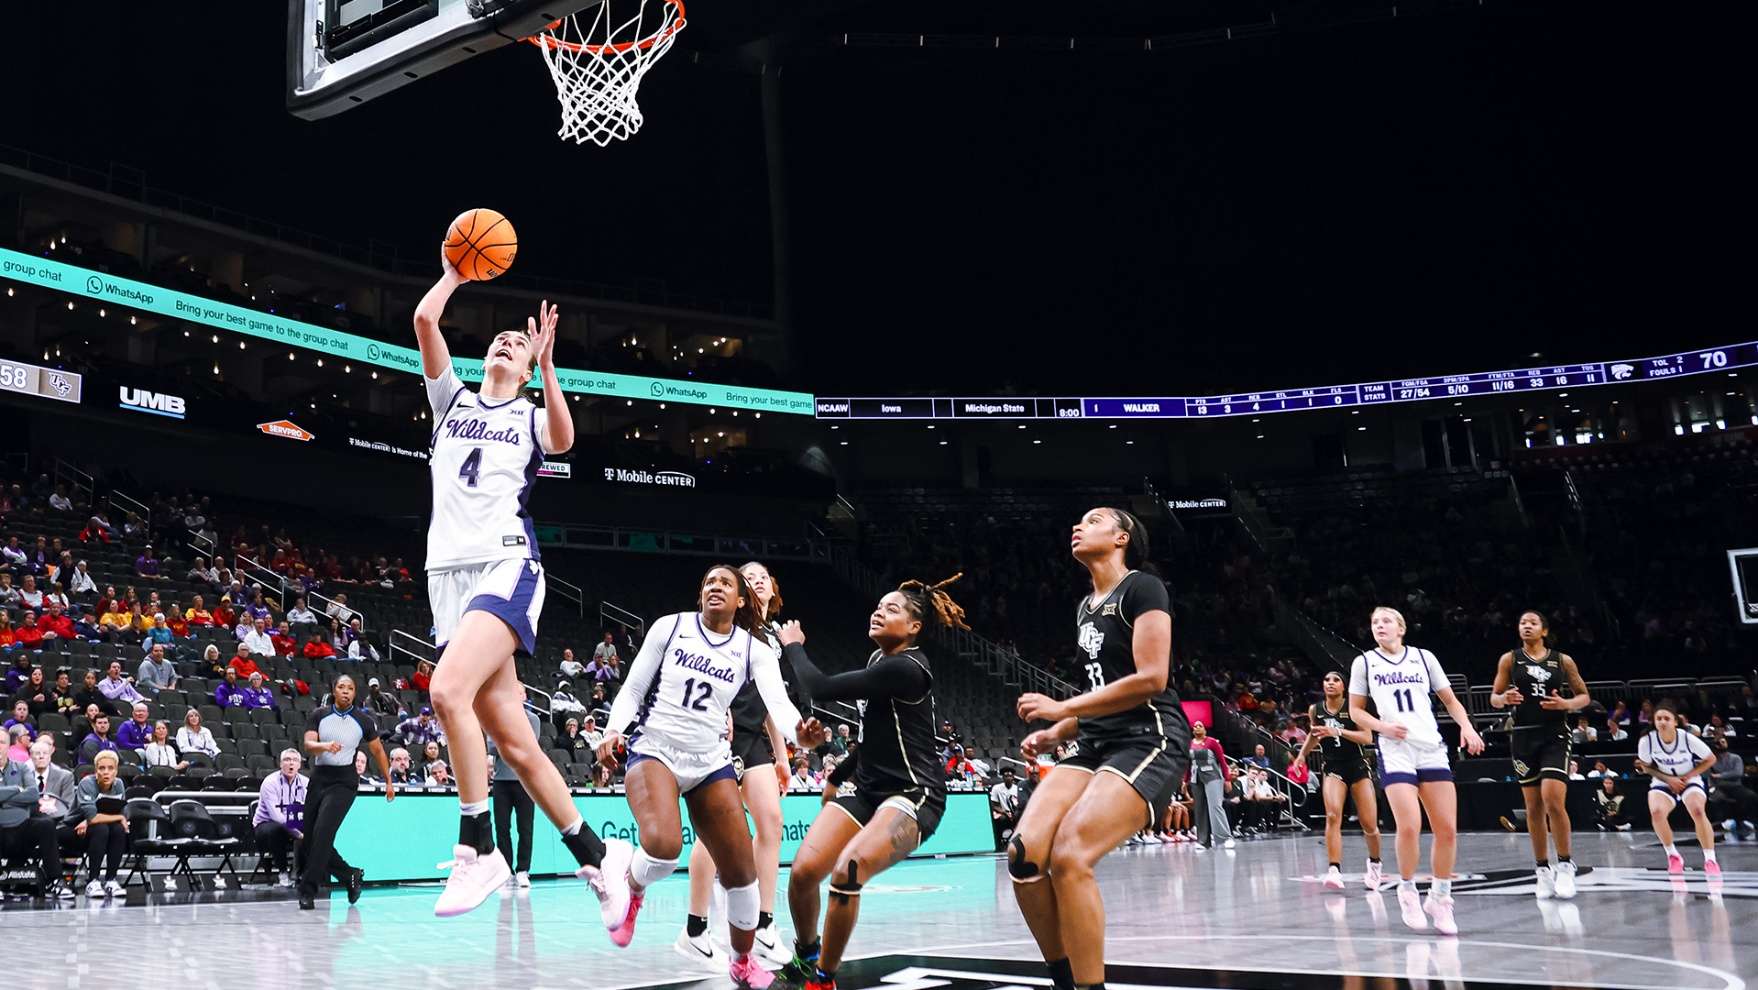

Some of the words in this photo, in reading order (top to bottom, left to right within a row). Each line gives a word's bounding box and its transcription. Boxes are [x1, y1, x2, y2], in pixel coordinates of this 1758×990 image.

[3, 260, 36, 276] group
[38, 267, 62, 281] chat
[105, 282, 154, 304] WhatsApp
[175, 300, 201, 317] Bring
[203, 308, 225, 320] your
[226, 312, 247, 326] best
[249, 319, 274, 333] game
[276, 324, 285, 335] to
[287, 326, 300, 339] the
[303, 332, 328, 347] group
[330, 337, 349, 350] chat
[381, 350, 420, 368] WhatsApp
[1652, 359, 1669, 367] TOL
[1676, 356, 1683, 364] 2
[1700, 351, 1727, 369] 70
[0, 364, 27, 388] 58
[1649, 367, 1676, 377] FOULS
[568, 378, 594, 389] group
[596, 381, 616, 390] chat
[665, 386, 707, 400] WhatsApp
[1364, 384, 1384, 393] TEAM
[1400, 387, 1430, 399] 27/54
[1448, 384, 1469, 396] 5/10
[1530, 378, 1544, 387] 33
[1586, 373, 1595, 383] 11
[119, 385, 186, 414] UMB
[726, 392, 748, 404] Bring
[750, 396, 768, 405] your
[770, 396, 787, 406] best
[790, 399, 812, 409] game
[1198, 405, 1208, 415] 13
[1224, 404, 1232, 413] 3
[1252, 402, 1260, 411] 4
[1334, 395, 1342, 405] 0
[1364, 392, 1386, 401] STATS
[817, 404, 848, 413] NCAAW
[881, 404, 901, 413] Iowa
[965, 403, 1002, 414] Michigan
[1003, 404, 1024, 413] State
[1123, 403, 1160, 413] WALKER
[268, 424, 303, 438] SERVPRO
[446, 418, 520, 446] Wildcats
[355, 439, 371, 449] Mobile
[397, 447, 412, 457] Home
[459, 447, 483, 488] 4
[616, 468, 653, 484] Mobile
[655, 475, 692, 487] CENTER
[1176, 500, 1199, 508] Mobile
[1078, 621, 1104, 660] UCF
[674, 648, 736, 684] Wildcats
[1084, 662, 1105, 692] 33
[1374, 671, 1424, 687] Wildcats
[681, 677, 713, 712] 12
[1531, 683, 1546, 696] 35
[1393, 688, 1415, 713] 11
